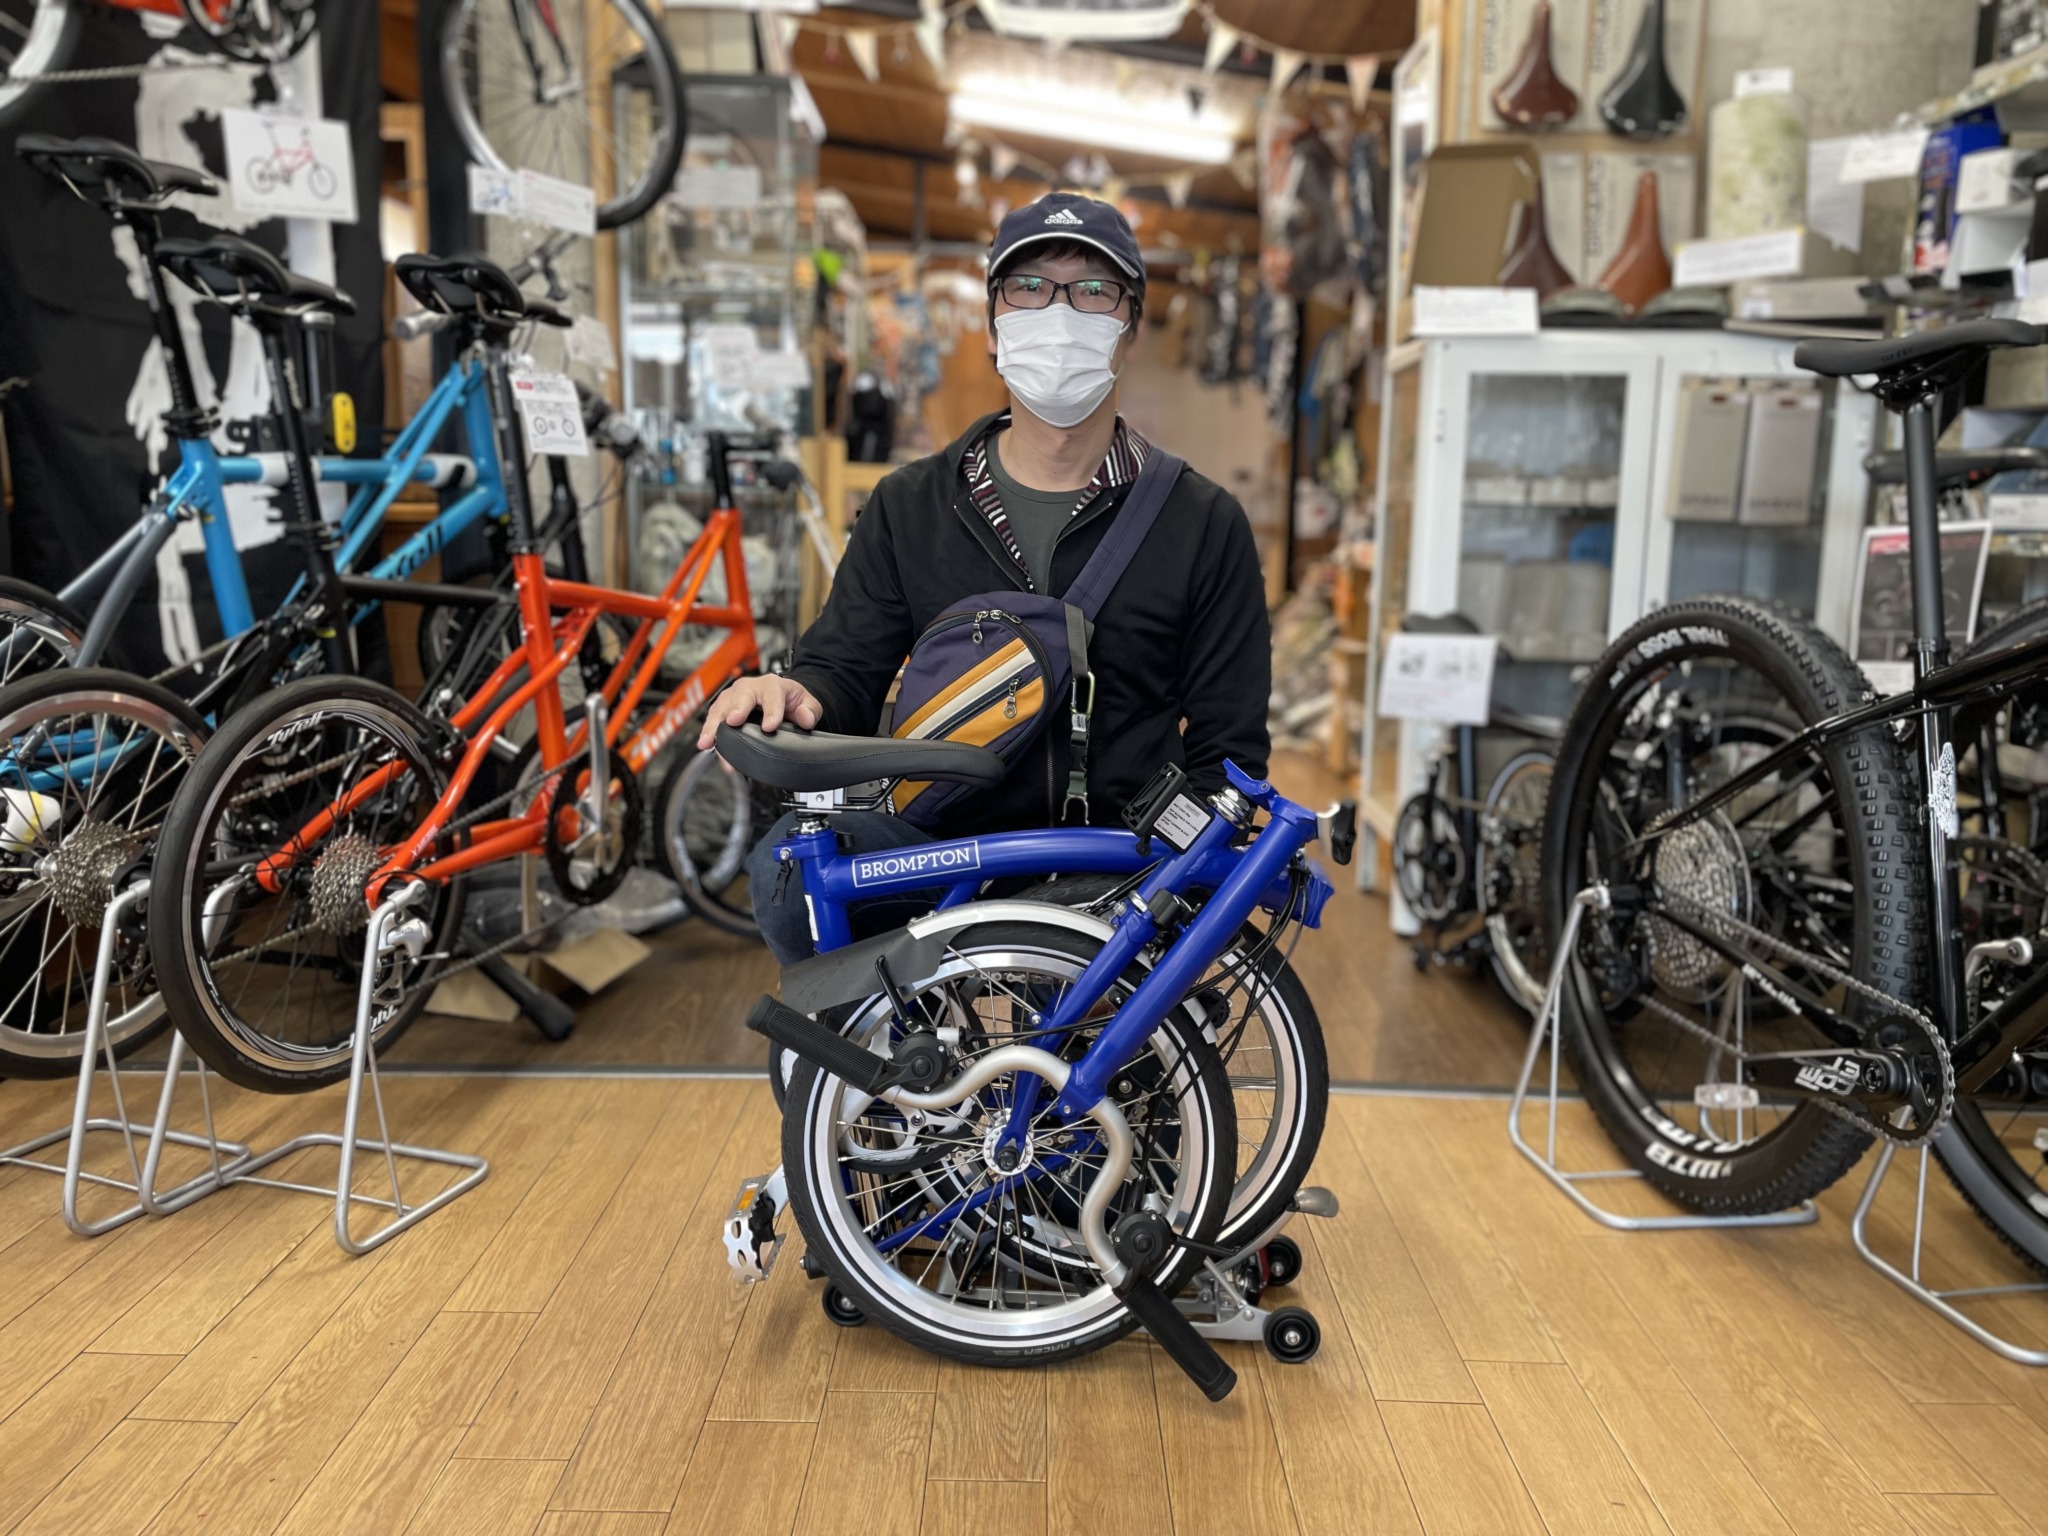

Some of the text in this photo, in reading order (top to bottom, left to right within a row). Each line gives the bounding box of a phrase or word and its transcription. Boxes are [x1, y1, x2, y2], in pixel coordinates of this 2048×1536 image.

[1638, 628, 1685, 659] BOSS
[1680, 626, 1730, 647] TRAIL
[267, 710, 324, 746] Tyrell
[860, 848, 970, 879] BROMPTON
[1645, 1141, 1724, 1179] WTB
[1023, 1341, 1071, 1356] RACER
